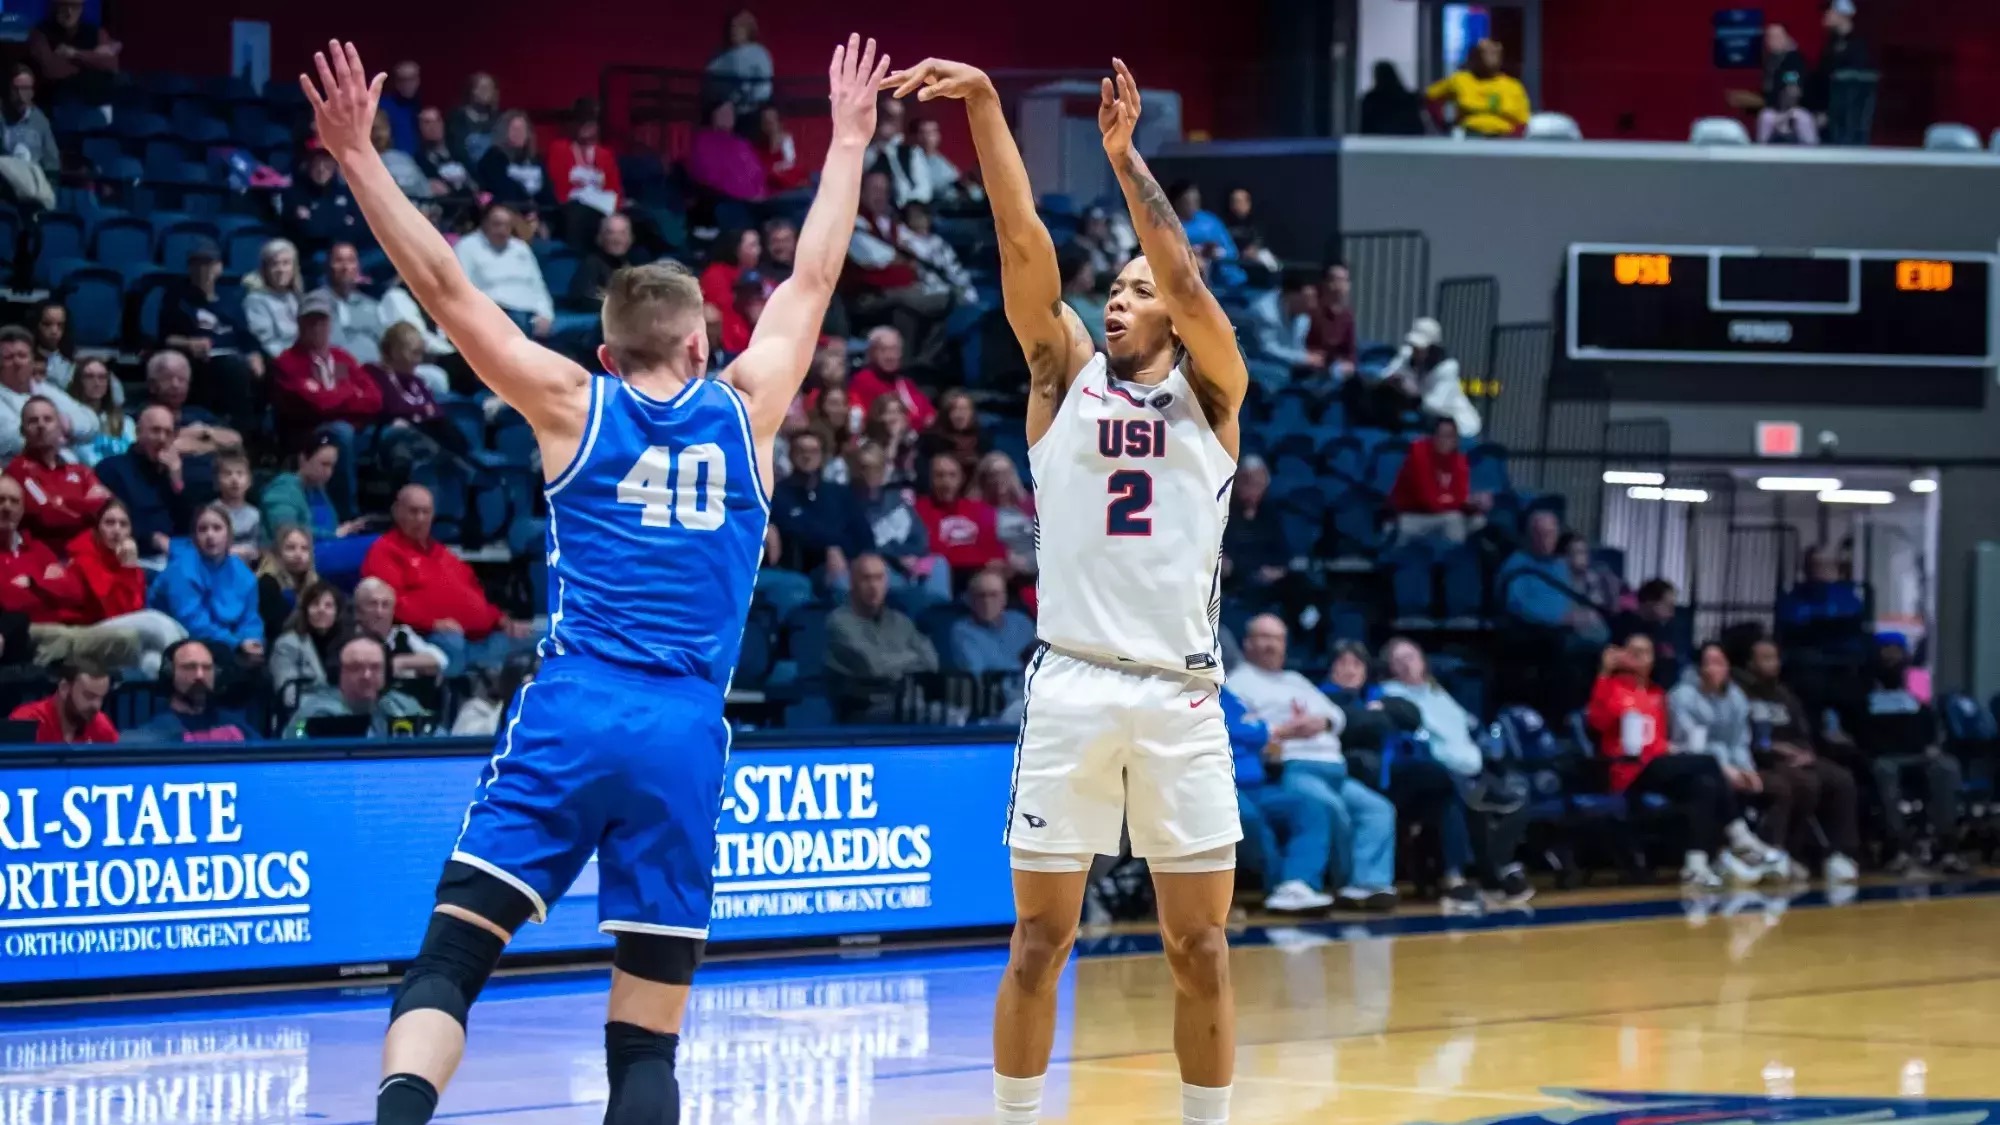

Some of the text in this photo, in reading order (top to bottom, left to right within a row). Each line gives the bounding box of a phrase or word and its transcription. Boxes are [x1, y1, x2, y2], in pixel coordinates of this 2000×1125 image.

[1097, 418, 1166, 458] USI
[615, 442, 728, 531] 40
[1106, 469, 1153, 537] 2
[712, 824, 932, 878] THOPAEDICS
[0, 850, 311, 911] RTHOPAEDICS
[5, 928, 163, 957] ORTHOPAEDIC
[165, 922, 253, 949] URGENT
[256, 918, 311, 943] CARE
